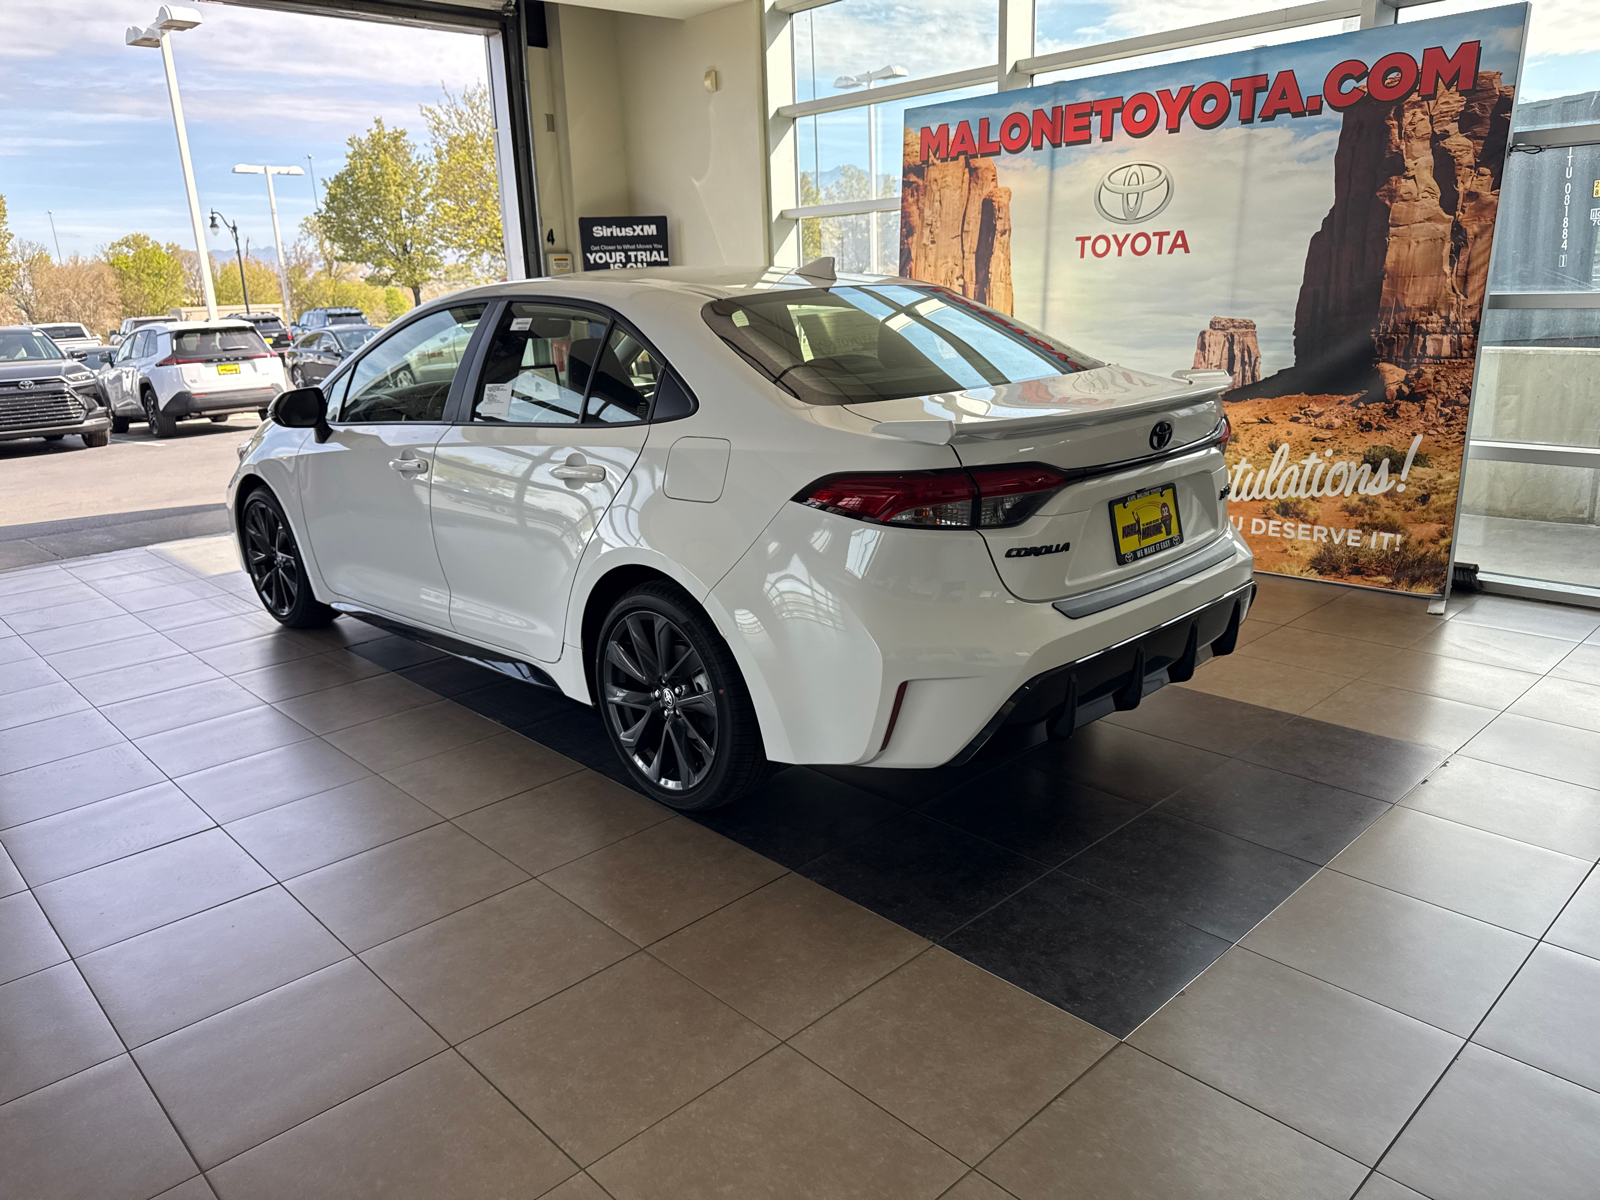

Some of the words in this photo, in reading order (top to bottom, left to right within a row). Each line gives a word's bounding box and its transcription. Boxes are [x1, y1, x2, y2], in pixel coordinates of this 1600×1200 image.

[919, 39, 1482, 162] MALONETOYOTA.COM
[1561, 182, 1572, 250] 081884
[546, 228, 555, 246] 4
[592, 224, 657, 237] SiriusXM
[1075, 230, 1191, 260] TOYOTA
[586, 252, 626, 264] YOUR
[628, 250, 669, 262] TRIAL
[1228, 434, 1423, 502] tulations!
[1162, 507, 1169, 516] 32
[1251, 518, 1363, 547] DESERVE
[1370, 531, 1402, 552] IT!
[1005, 542, 1070, 558] COROLLA
[1136, 550, 1144, 558] WE
[1144, 546, 1156, 555] MAKE
[1156, 543, 1161, 552] IT
[1161, 540, 1171, 550] EASY
